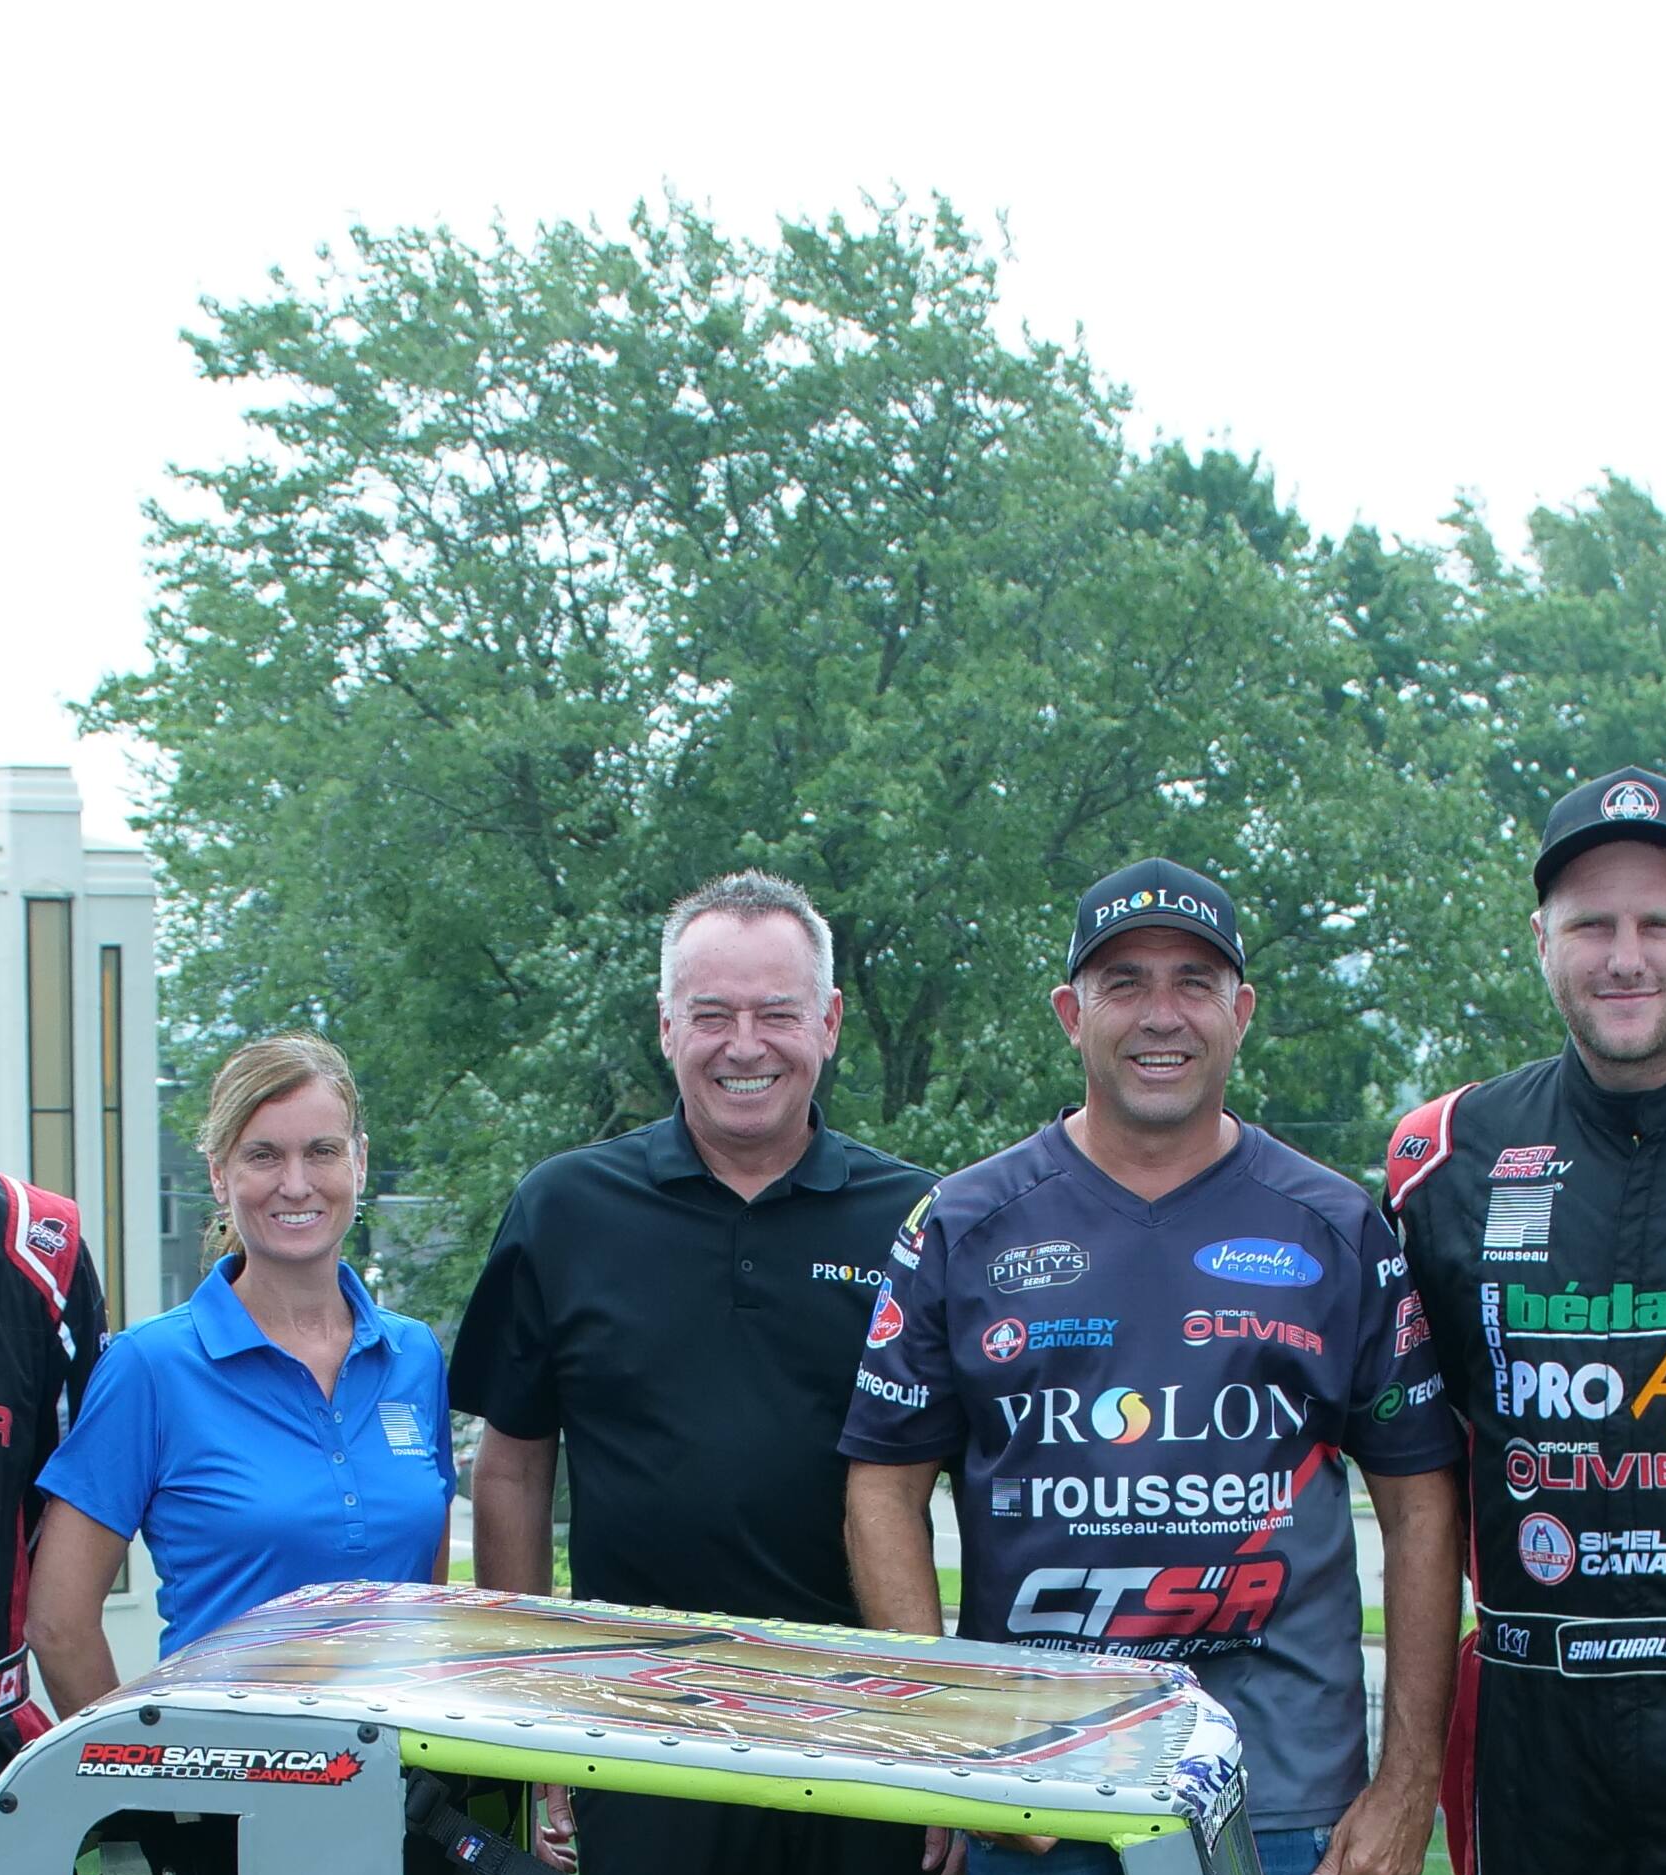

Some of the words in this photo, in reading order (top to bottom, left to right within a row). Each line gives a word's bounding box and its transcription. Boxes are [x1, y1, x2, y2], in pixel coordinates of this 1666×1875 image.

[1094, 888, 1219, 928] PROLON
[1497, 1146, 1557, 1164] FESTI
[993, 1254, 1084, 1281] PINTY'S
[1212, 1245, 1293, 1269] Jacombs
[1482, 1249, 1548, 1263] rousseau
[811, 1263, 887, 1286] PROLO
[1214, 1309, 1257, 1317] GROUPE
[1028, 1318, 1119, 1333] SHELBY
[1183, 1316, 1324, 1356] OLIVIER
[1028, 1332, 1113, 1350] CANADA
[1480, 1281, 1511, 1416] GROUPE
[856, 1362, 930, 1408] erreault
[1511, 1359, 1624, 1421] PRO
[1537, 1441, 1600, 1453] GROUPE
[1032, 1469, 1293, 1518] rousseau
[1068, 1513, 1294, 1537] rousseau-automotive.com
[1520, 1548, 1572, 1566] SHELBY
[1567, 1638, 1605, 1661] SAM
[81, 1743, 328, 1770] PRO1SAFETY.CA
